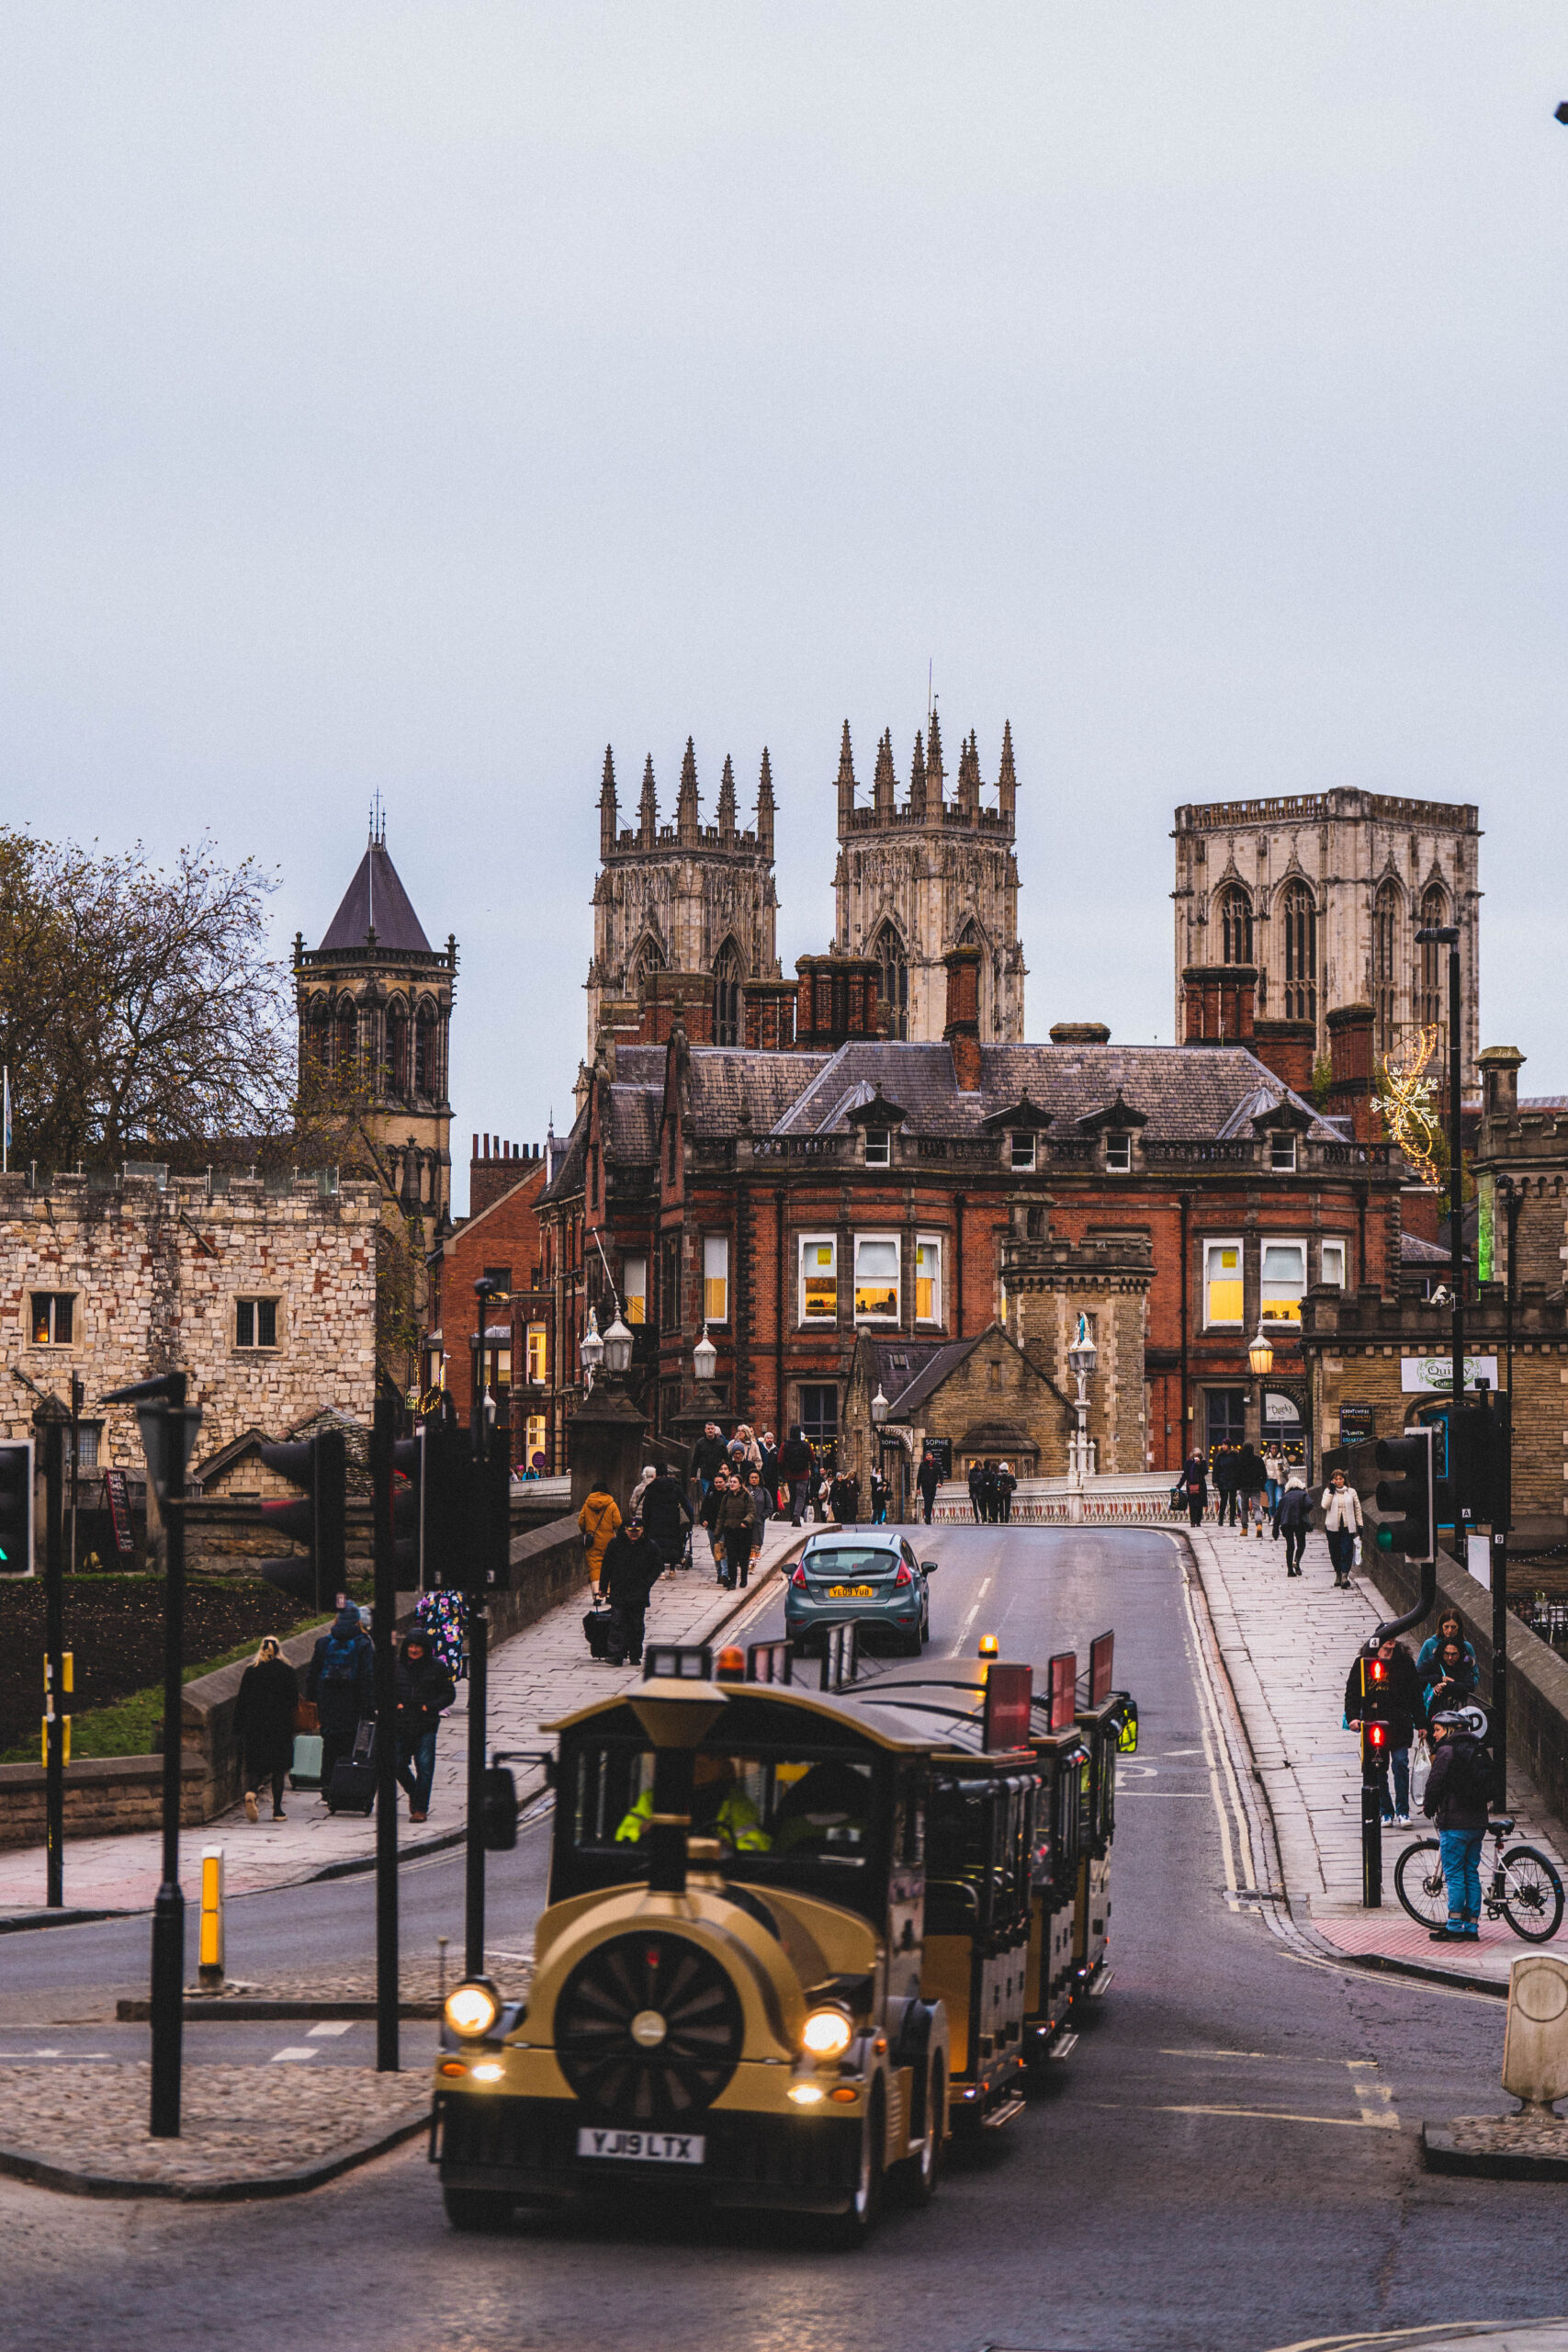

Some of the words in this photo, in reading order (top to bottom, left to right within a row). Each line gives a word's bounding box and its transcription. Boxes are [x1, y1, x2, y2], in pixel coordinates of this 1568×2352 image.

[1427, 1365, 1471, 1378] Quiy
[1371, 1638, 1377, 1646] 4
[647, 2135, 691, 2159] LTX
